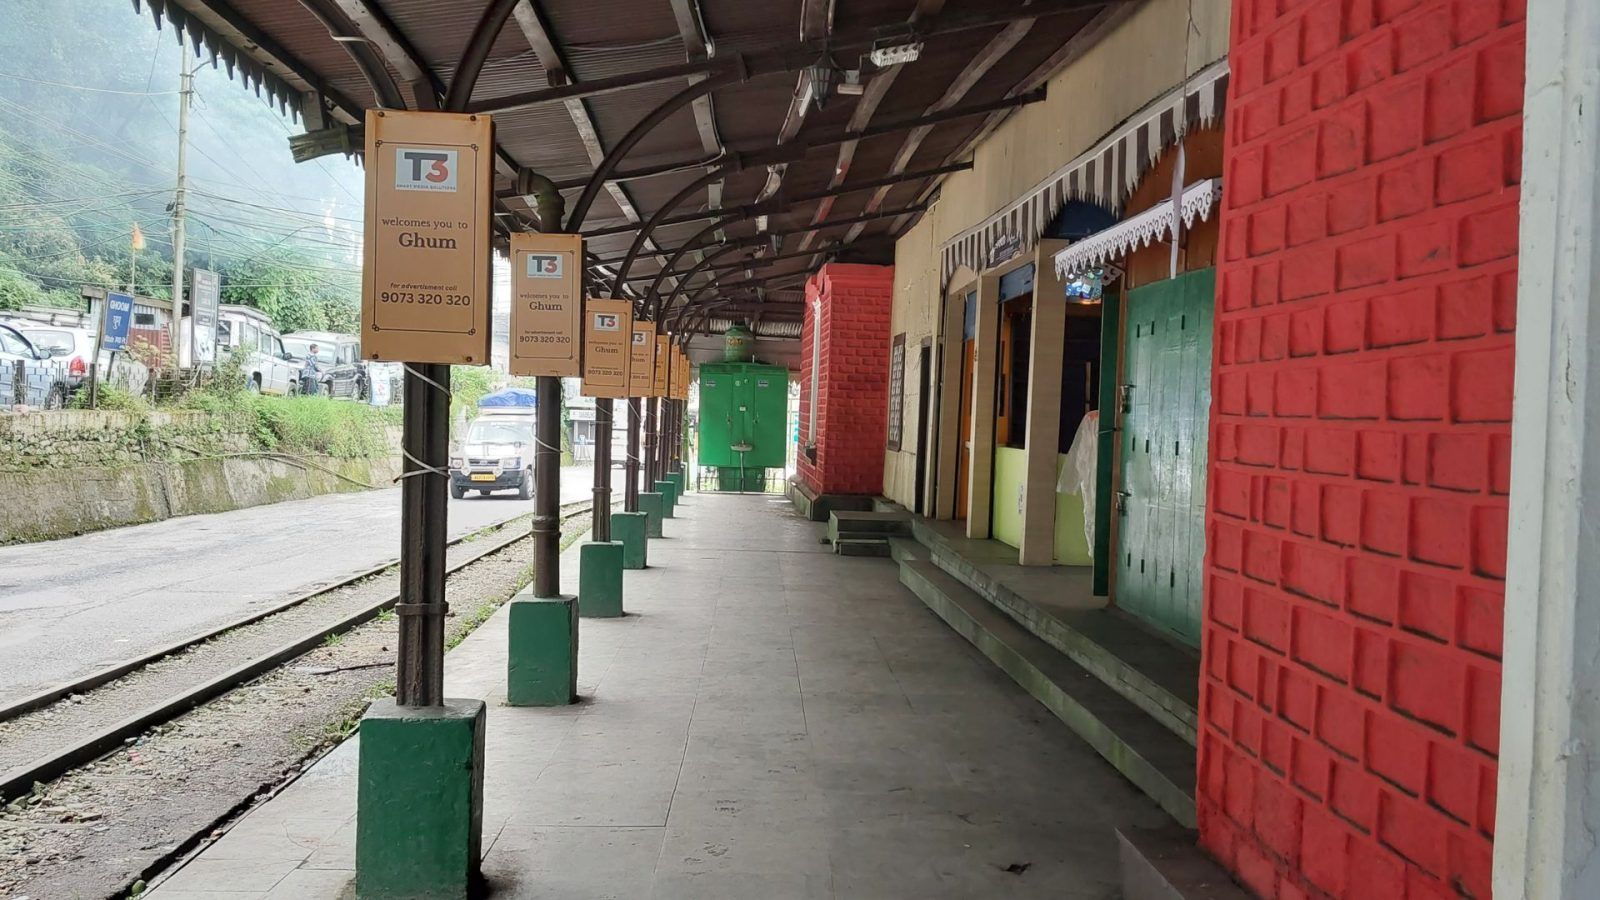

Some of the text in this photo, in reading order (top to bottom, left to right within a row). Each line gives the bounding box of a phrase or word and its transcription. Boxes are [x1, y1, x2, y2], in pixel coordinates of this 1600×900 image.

[404, 152, 448, 182] T3
[382, 217, 468, 230] welcomes you to
[398, 232, 457, 250] Ghum
[532, 256, 557, 273] T3
[381, 292, 471, 306] 9073 320 320
[529, 301, 562, 310] Ghum
[598, 315, 615, 327] T3
[595, 346, 619, 354] Ghum
